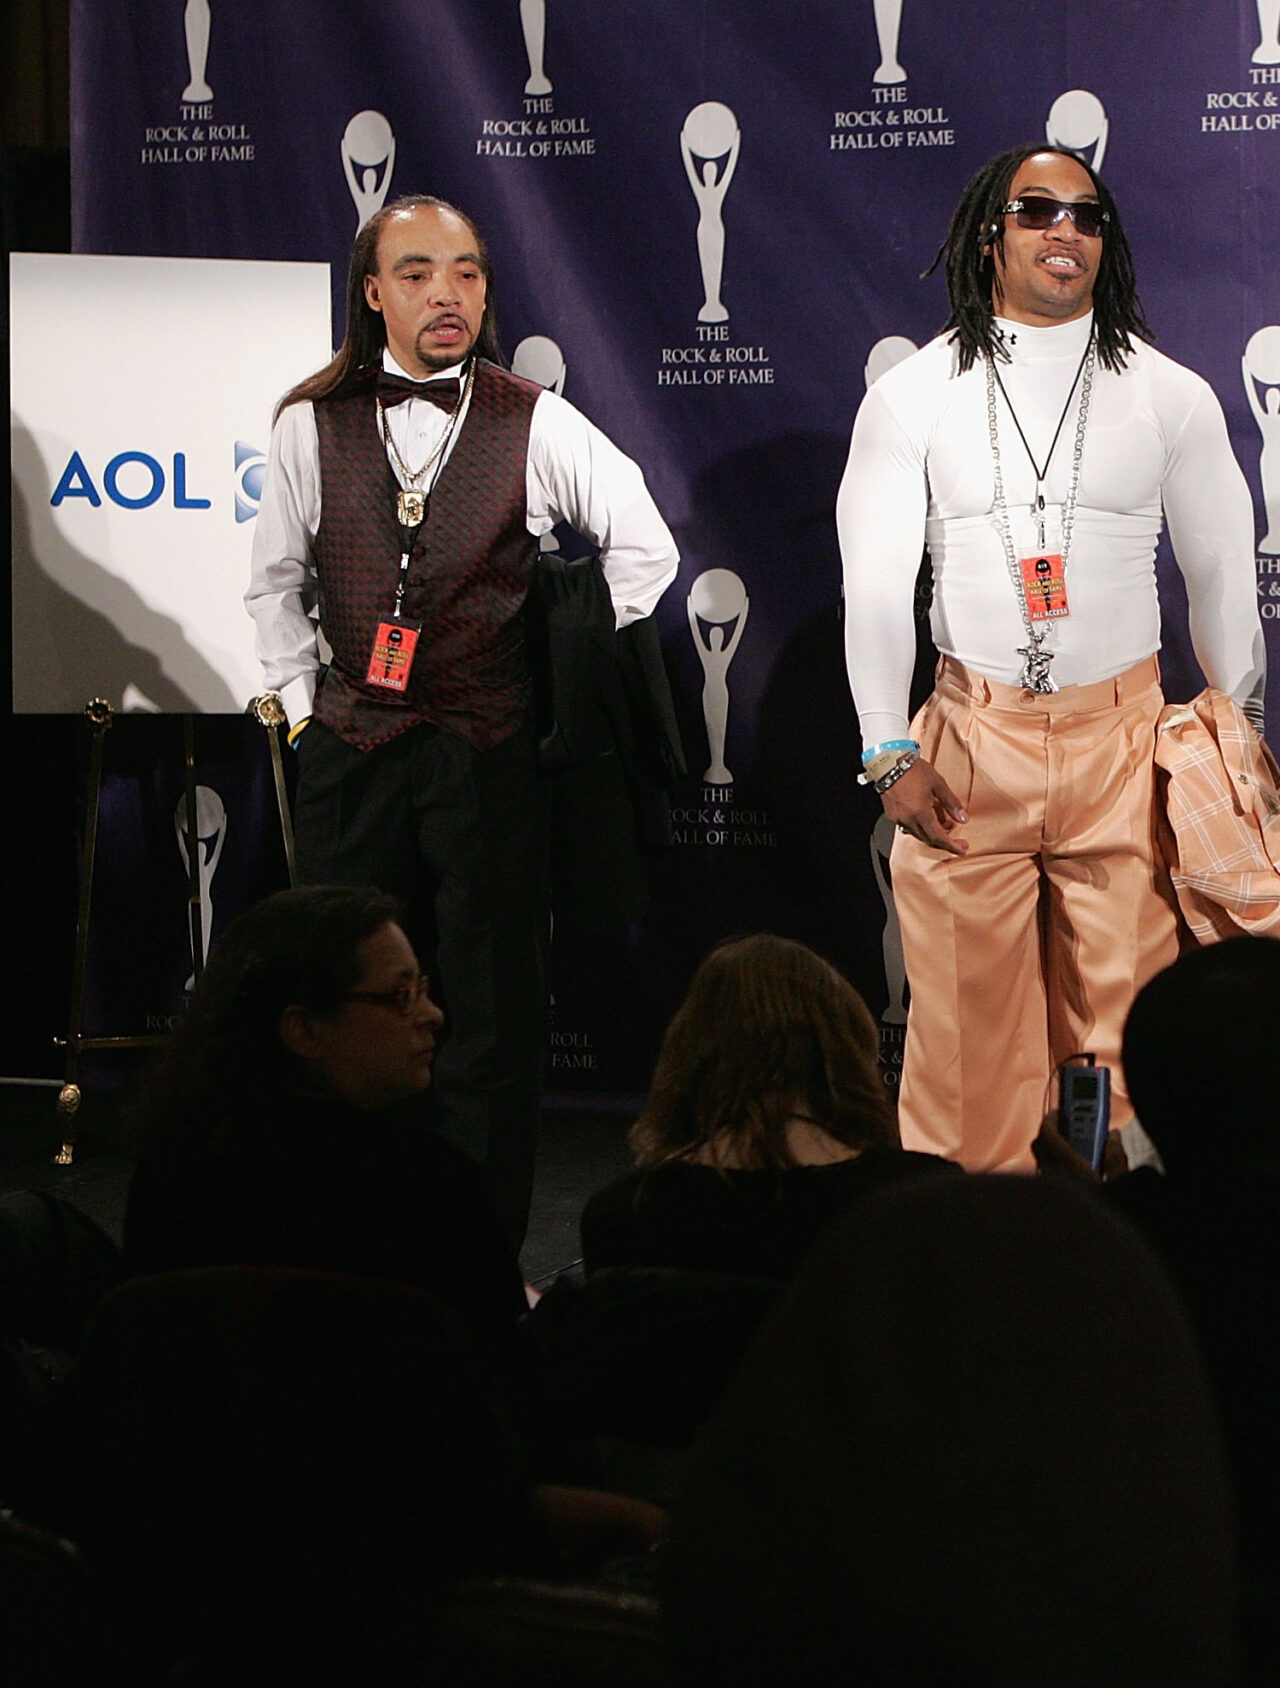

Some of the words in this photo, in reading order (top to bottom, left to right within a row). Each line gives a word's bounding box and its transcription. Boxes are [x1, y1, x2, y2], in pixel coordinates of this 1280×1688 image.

[871, 86, 908, 104] THE
[1206, 91, 1260, 109] ROCK
[1262, 91, 1278, 107] &
[179, 105, 213, 121] THE
[522, 98, 554, 115] THE
[834, 110, 883, 128] ROCK
[885, 110, 900, 126] &
[902, 107, 949, 125] ROLL
[1201, 114, 1254, 132] HALL
[145, 126, 189, 143] ROCK
[191, 126, 205, 142] &
[207, 124, 251, 141] ROLL
[482, 119, 533, 137] ROCK
[535, 120, 549, 135] &
[551, 118, 591, 135] ROLL
[476, 139, 527, 157] HALL
[528, 140, 552, 157] OF
[553, 139, 596, 156] FAME
[829, 133, 879, 150] HALL
[879, 131, 904, 148] OF
[907, 129, 955, 147] FAME
[141, 147, 183, 164] HALL
[183, 146, 208, 162] OF
[210, 145, 256, 162] FAME
[695, 325, 730, 342] THE
[661, 348, 706, 364] ROCK
[709, 348, 723, 363] &
[725, 346, 769, 363] ROLL
[657, 369, 702, 385] HALL
[703, 369, 727, 385] OF
[729, 368, 775, 384] FAME
[50, 451, 212, 510] AOL
[703, 787, 735, 803] THE
[669, 807, 710, 825] OCK
[713, 808, 726, 824] &
[673, 829, 703, 845] ALL
[706, 830, 729, 846] OF
